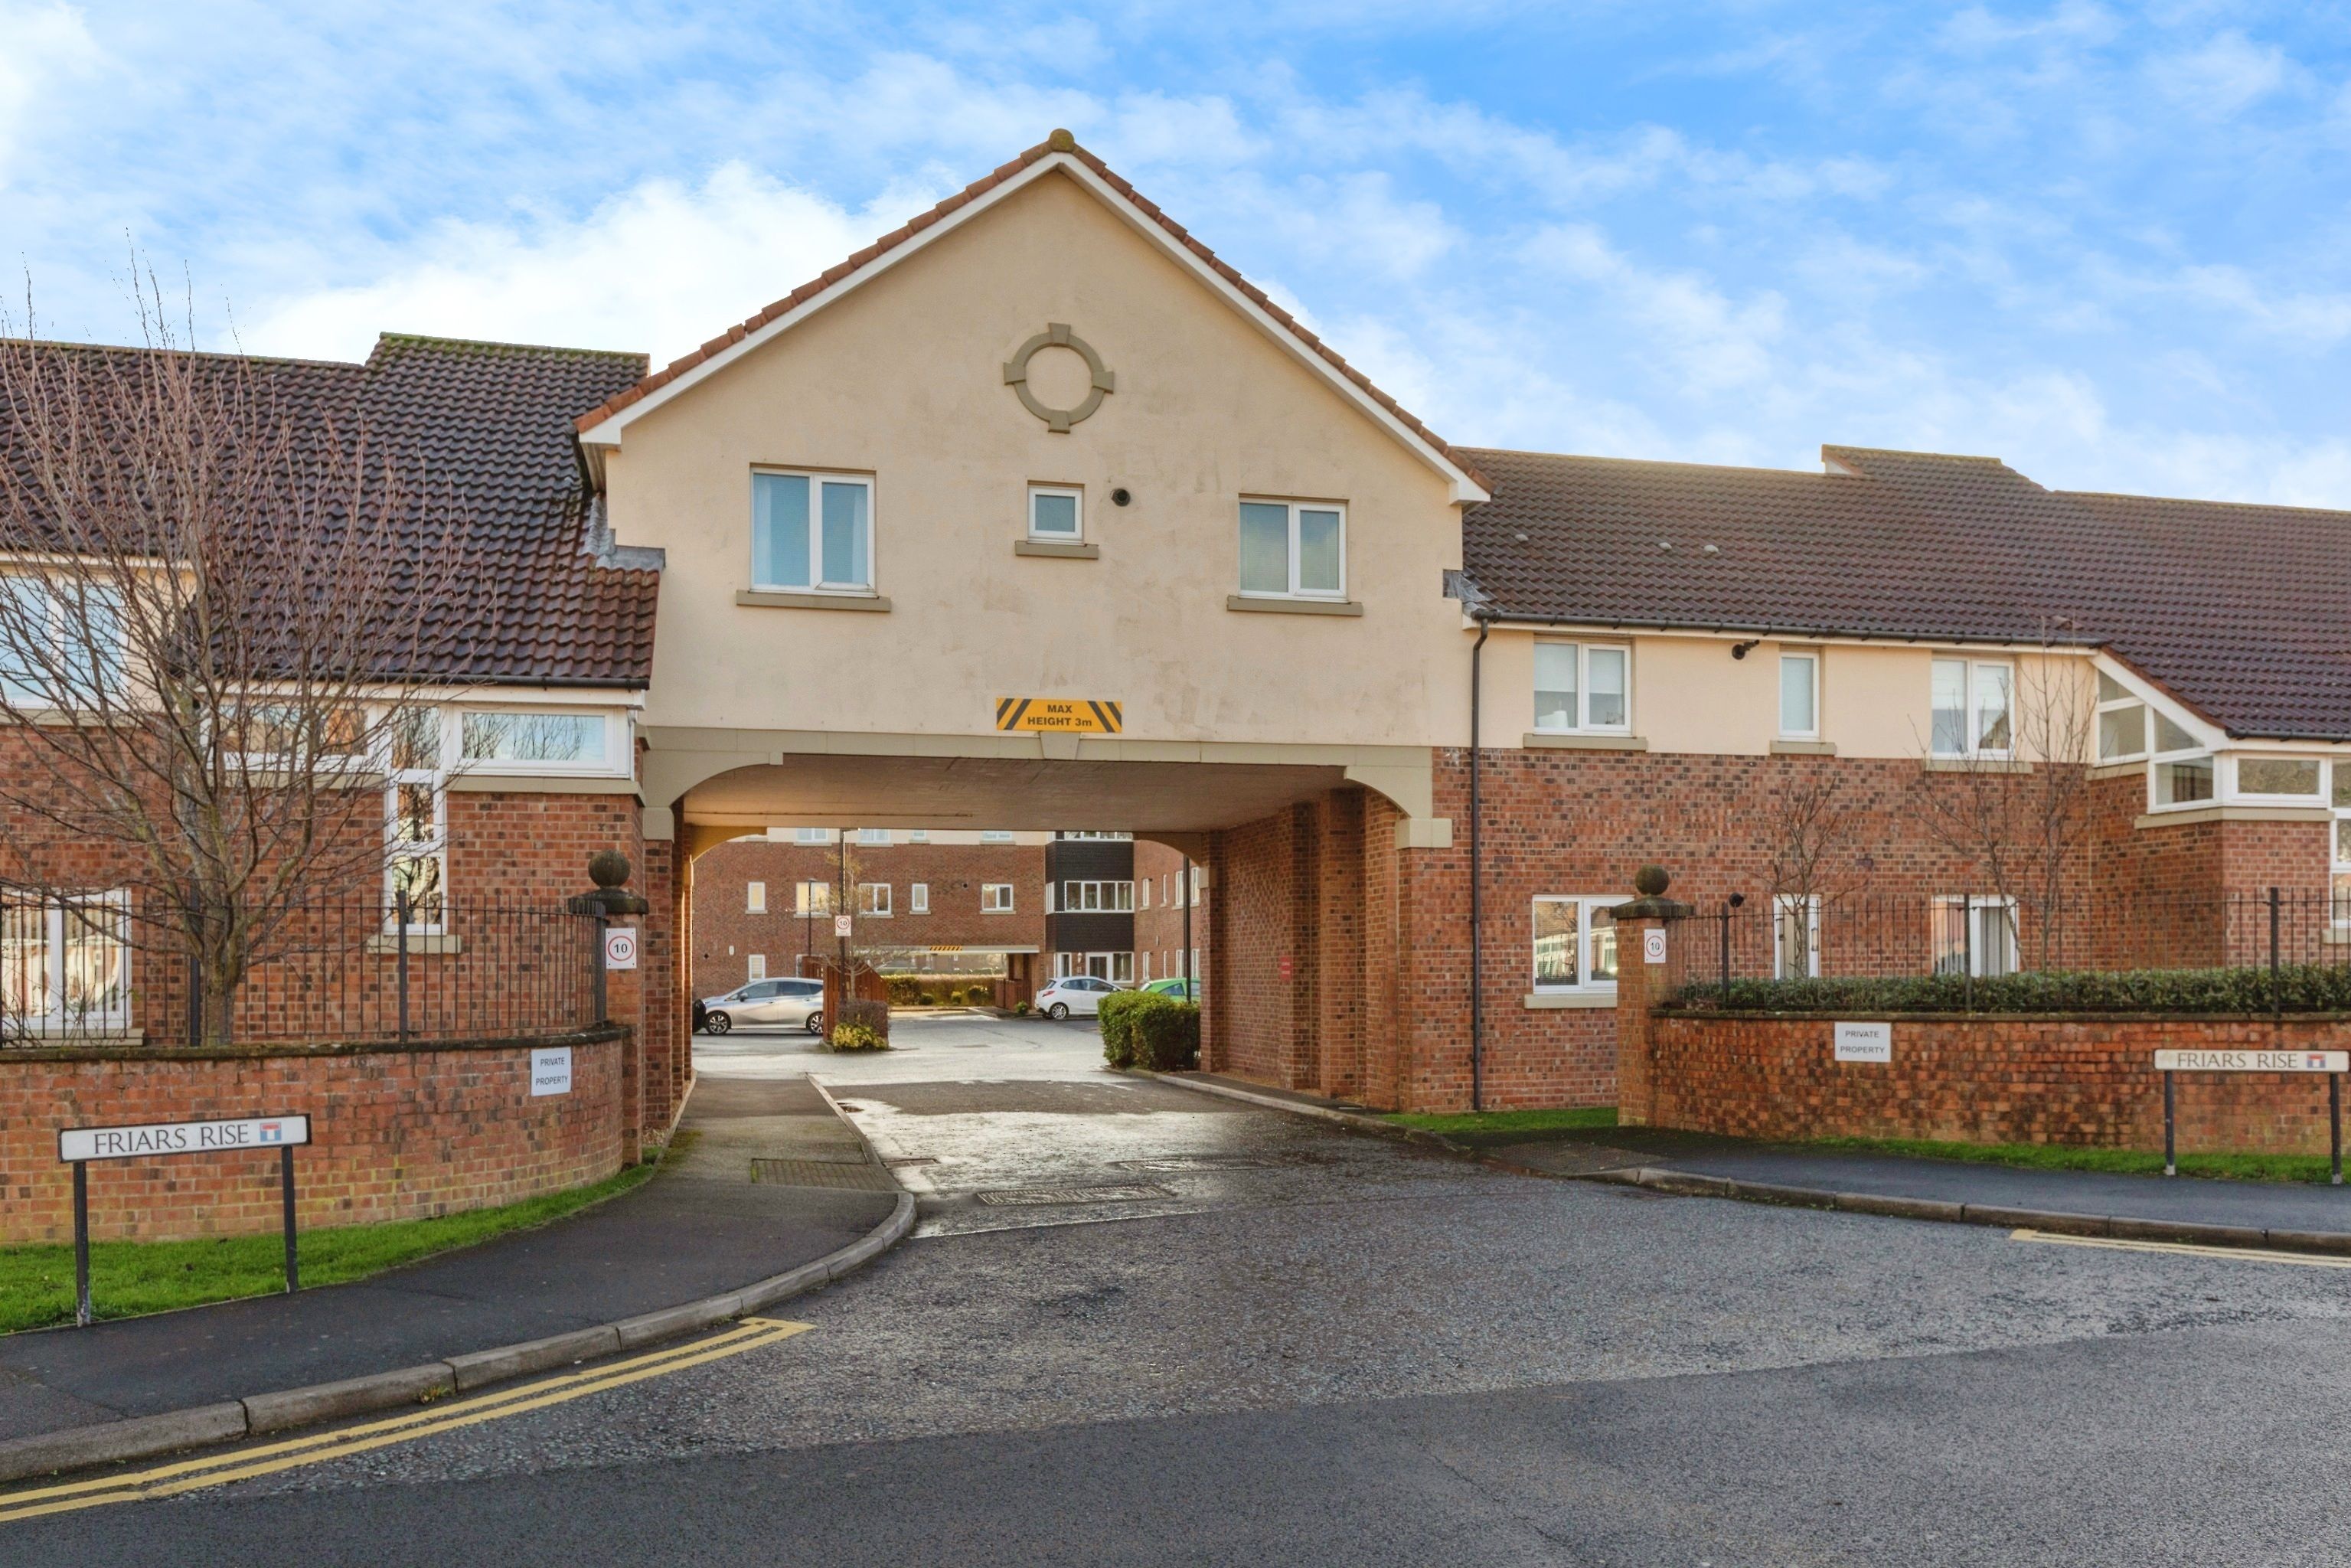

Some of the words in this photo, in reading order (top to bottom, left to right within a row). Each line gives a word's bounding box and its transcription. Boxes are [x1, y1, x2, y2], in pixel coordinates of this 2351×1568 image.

[1047, 704, 1073, 714] MAX
[1027, 716, 1072, 727] HEIGHT
[1075, 717, 1092, 727] 3m
[614, 943, 628, 953] 10
[1651, 942, 1660, 951] 10
[1845, 1030, 1880, 1038] PRIVATE
[1840, 1045, 1885, 1054] PROPERTY
[540, 1057, 565, 1067] PRIVATE
[2177, 1052, 2247, 1068] FRIARS
[2257, 1053, 2298, 1068] RISE
[535, 1075, 569, 1086] PROPERTY
[93, 1128, 187, 1155] FRIARS
[199, 1123, 250, 1147] RISE
